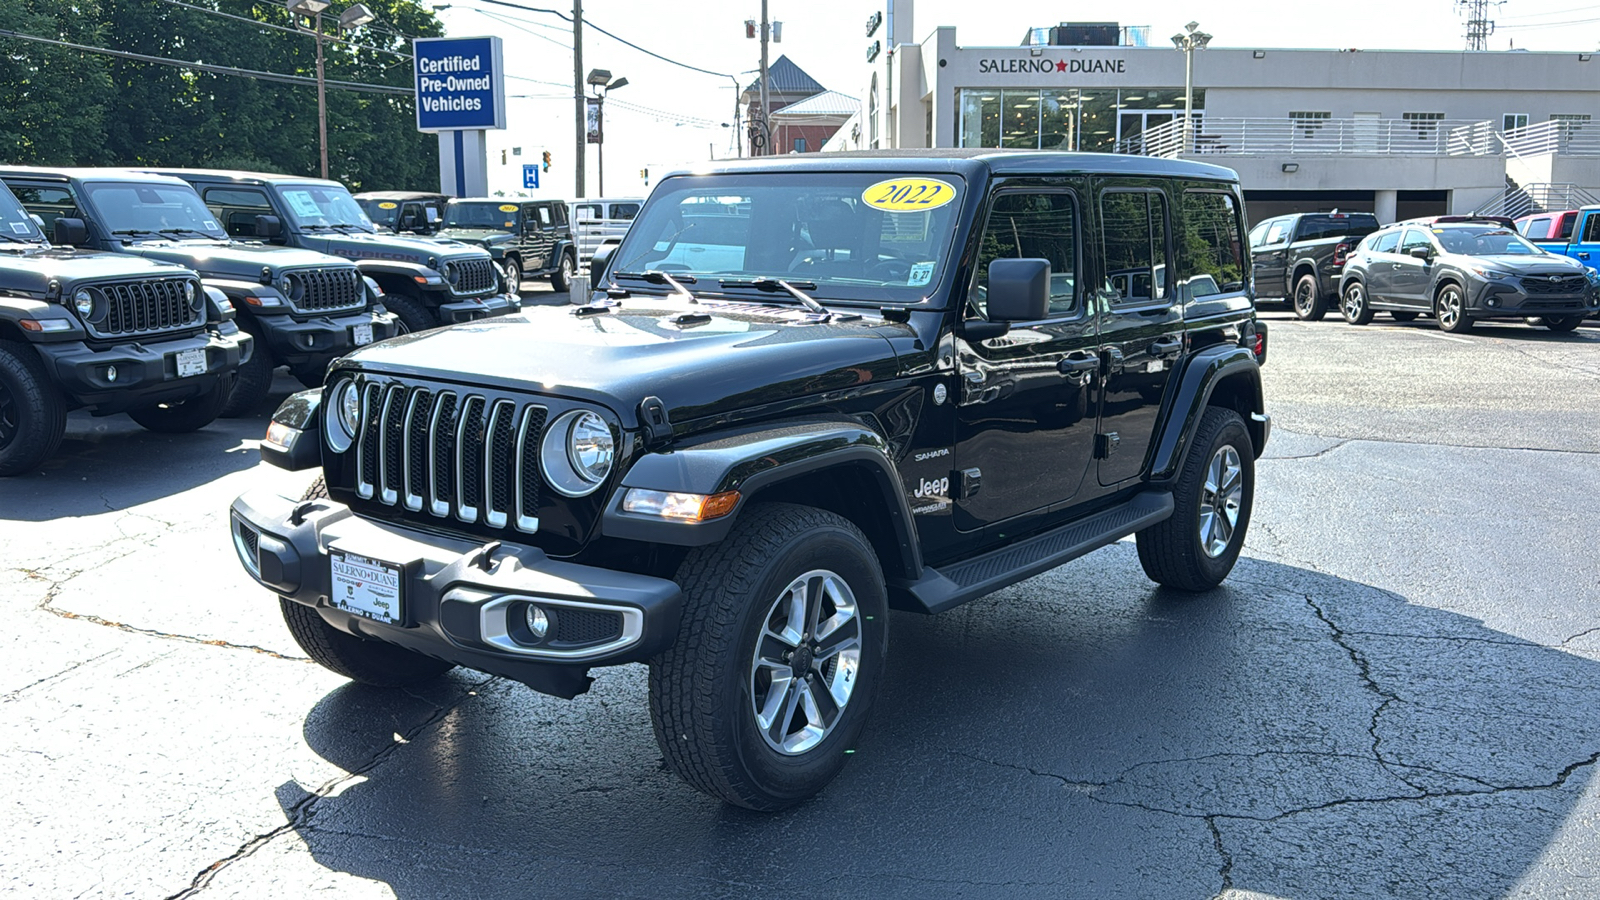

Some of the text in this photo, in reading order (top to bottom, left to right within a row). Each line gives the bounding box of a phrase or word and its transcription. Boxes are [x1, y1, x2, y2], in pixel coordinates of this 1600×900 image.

[420, 55, 480, 73] Certified
[979, 59, 1125, 73] SALERNO DUANE
[421, 74, 490, 92] Pre-Owned
[422, 95, 482, 112] Vehicles
[526, 169, 536, 182] H
[874, 185, 942, 204] 2022
[334, 248, 420, 262] RUBICON
[913, 270, 930, 280] 6 27
[915, 448, 950, 462] SAHARA
[914, 477, 949, 498] Jeep
[333, 561, 398, 588] SALERNO DUANE
[373, 597, 390, 611] Jeep
